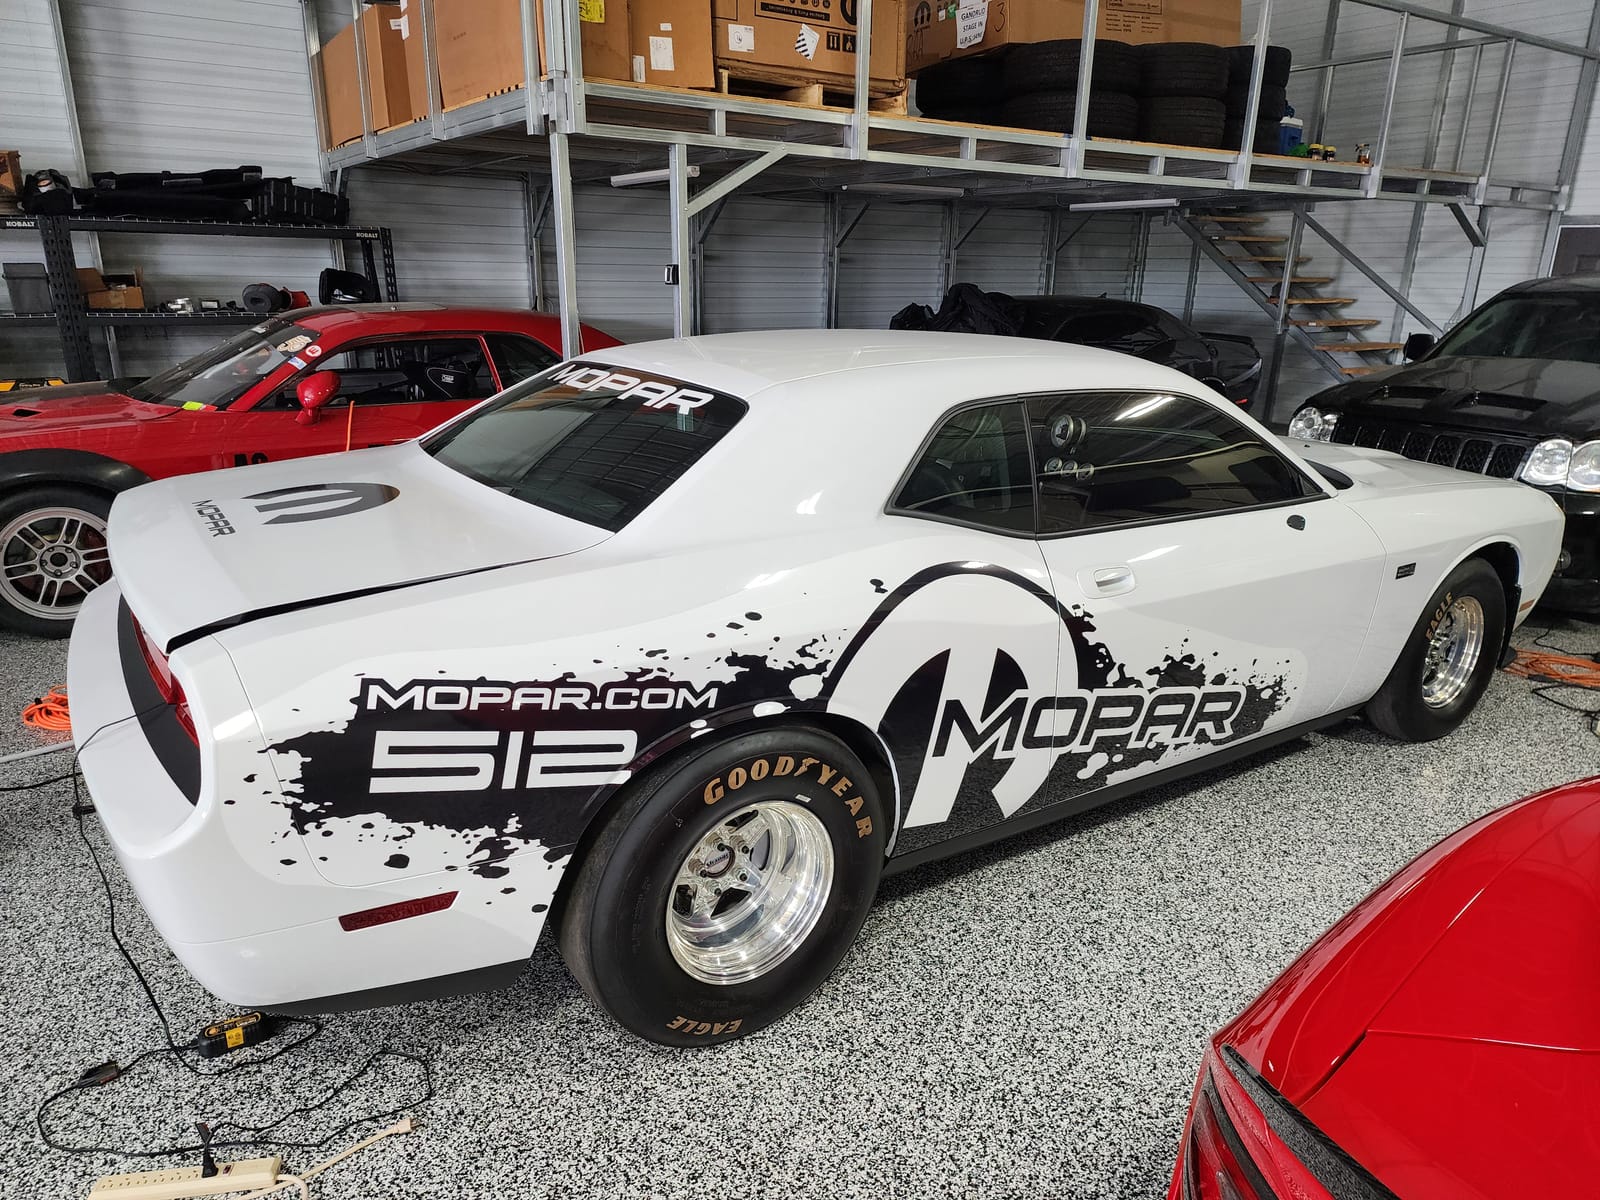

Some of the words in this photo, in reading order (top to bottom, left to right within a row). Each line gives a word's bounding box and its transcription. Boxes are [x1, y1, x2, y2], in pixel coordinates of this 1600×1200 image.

[548, 364, 714, 415] MOPAR
[192, 499, 236, 537] MOPAR
[1425, 591, 1453, 641] EAGLE
[366, 684, 719, 711] MOPAR.COM
[931, 688, 1245, 761] MOPAR
[368, 729, 638, 794] 512
[703, 756, 873, 838] GOODYEAR
[665, 1015, 743, 1036] EAGLE
